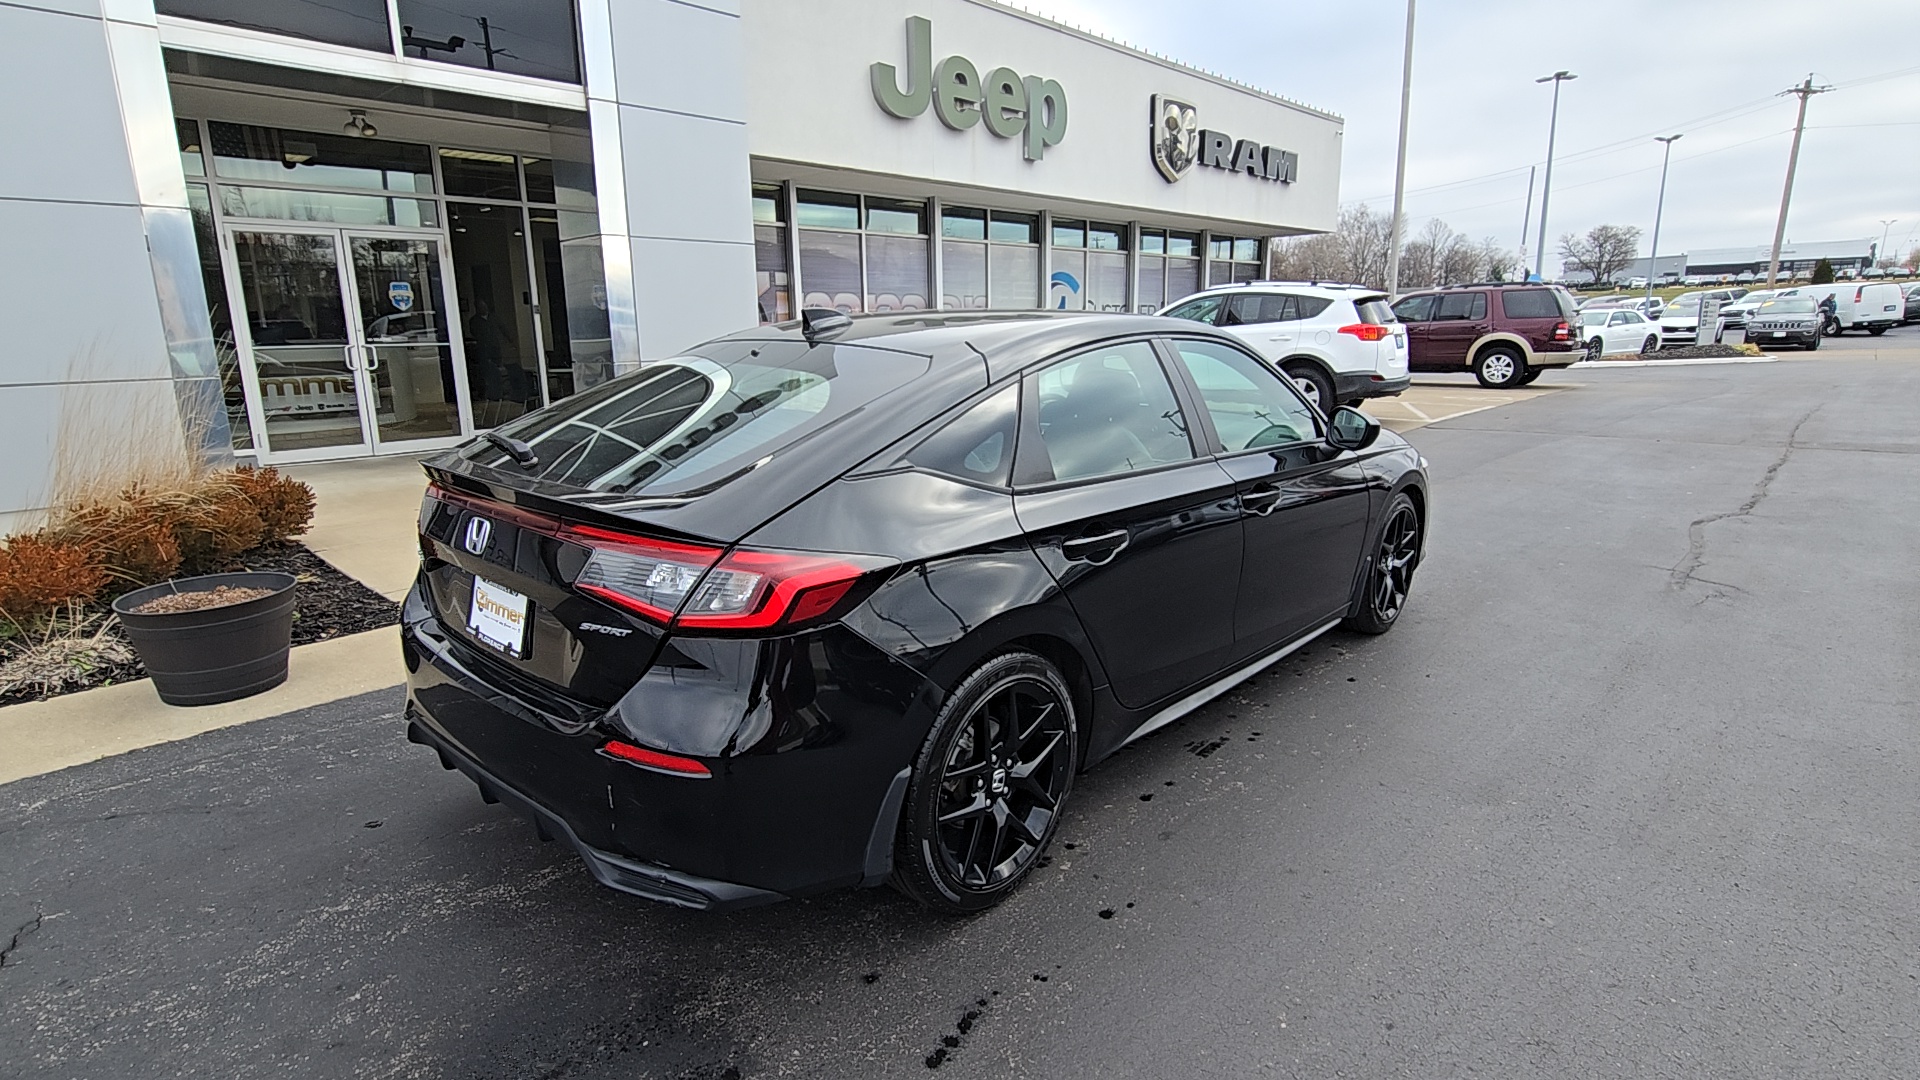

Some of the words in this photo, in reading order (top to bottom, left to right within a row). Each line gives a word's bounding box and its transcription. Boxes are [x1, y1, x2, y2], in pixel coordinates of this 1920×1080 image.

[869, 15, 1068, 161] Jeep
[1197, 128, 1300, 185] RAM
[579, 622, 633, 637] SPORT
